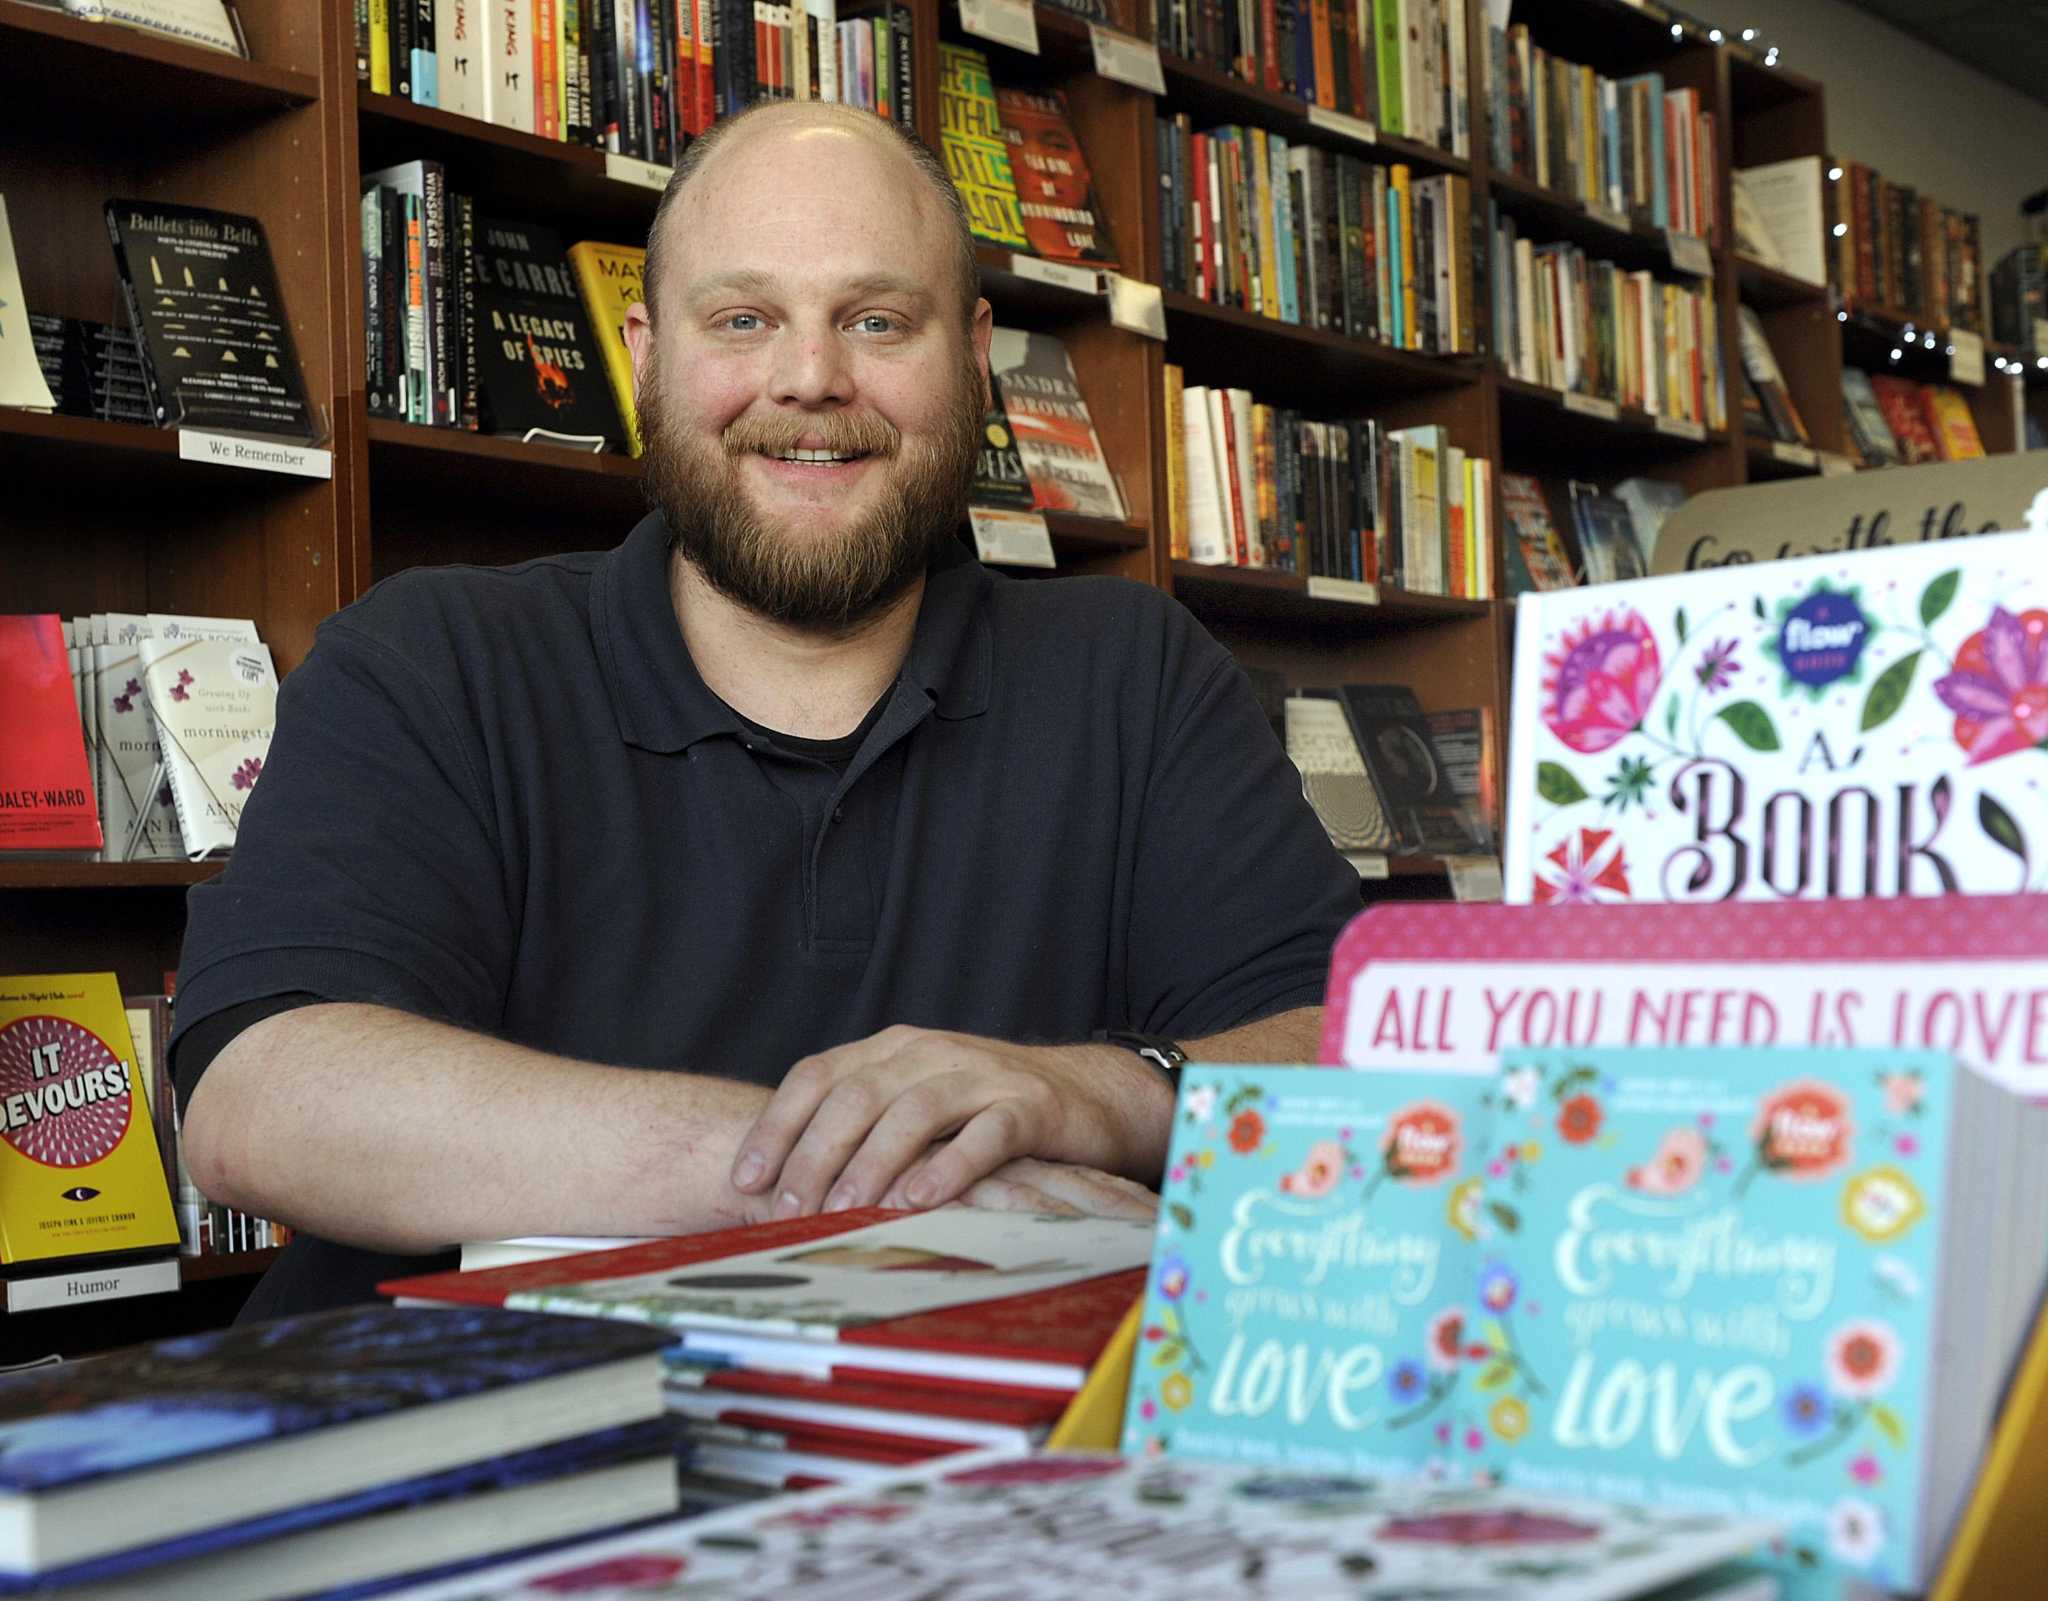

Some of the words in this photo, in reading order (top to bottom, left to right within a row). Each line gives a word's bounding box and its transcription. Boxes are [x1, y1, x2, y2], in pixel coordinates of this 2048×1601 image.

[505, 8, 517, 56] KING
[455, 57, 467, 76] IT
[506, 72, 519, 91] IT
[580, 55, 591, 95] WILDE
[567, 87, 580, 127] LEHANE
[581, 97, 592, 127] LAKE
[426, 172, 438, 248] WINSPEAR
[463, 203, 473, 230] THE
[130, 213, 184, 235] Bullets
[189, 219, 218, 240] into
[223, 225, 259, 246] Bells
[488, 228, 529, 252] JOHN
[464, 237, 473, 284] GATES
[475, 254, 491, 284] E
[496, 258, 577, 299] CARRÉ
[598, 258, 645, 279] MA
[369, 275, 378, 309] CABIN
[465, 291, 474, 309] OF
[370, 312, 378, 326] 10
[492, 310, 506, 331] A
[509, 312, 577, 342] LEGACY
[408, 307, 424, 371] WINSLOW
[502, 339, 525, 362] OF
[534, 344, 586, 370] SPIES
[466, 318, 477, 408] EVANGELINE
[1000, 373, 1080, 399] SANDRA
[1010, 395, 1091, 420] BROWN
[209, 440, 231, 457] We
[235, 444, 306, 467] Remember
[1786, 617, 1864, 652] flow
[119, 740, 161, 752] morn
[184, 724, 271, 741] morningsta
[1798, 729, 1837, 774] A
[0, 789, 86, 808] ALEY-WARD
[1371, 986, 1458, 1052] ALL
[1482, 987, 1604, 1053] YOU
[1624, 987, 1780, 1047] NEED
[1808, 988, 1864, 1047] IS
[1893, 988, 2048, 1064] LOVE
[31, 1042, 62, 1080] IT
[1220, 1187, 1442, 1306] Everything
[1553, 1182, 1838, 1321] Everything
[67, 1279, 120, 1297] Humor
